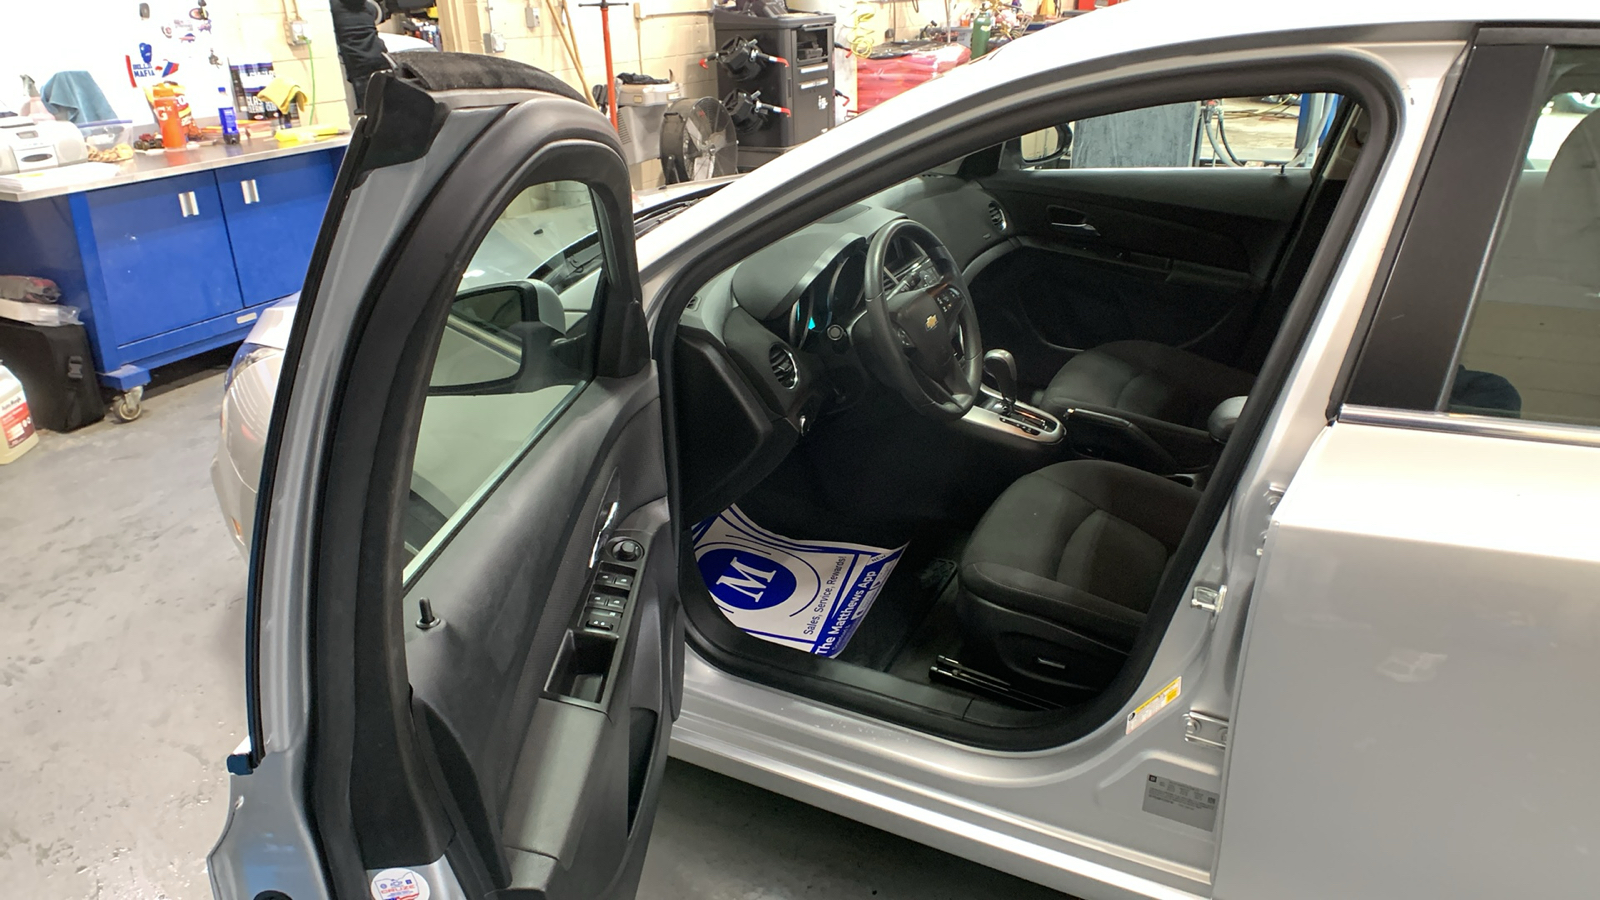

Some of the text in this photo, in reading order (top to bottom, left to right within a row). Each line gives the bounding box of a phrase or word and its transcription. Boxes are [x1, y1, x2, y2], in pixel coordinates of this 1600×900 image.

[716, 557, 777, 602] M
[803, 555, 847, 635] Sales, Service, Rewards!
[815, 637, 835, 654] The
[828, 590, 864, 635] Matthews
[857, 571, 877, 588] App
